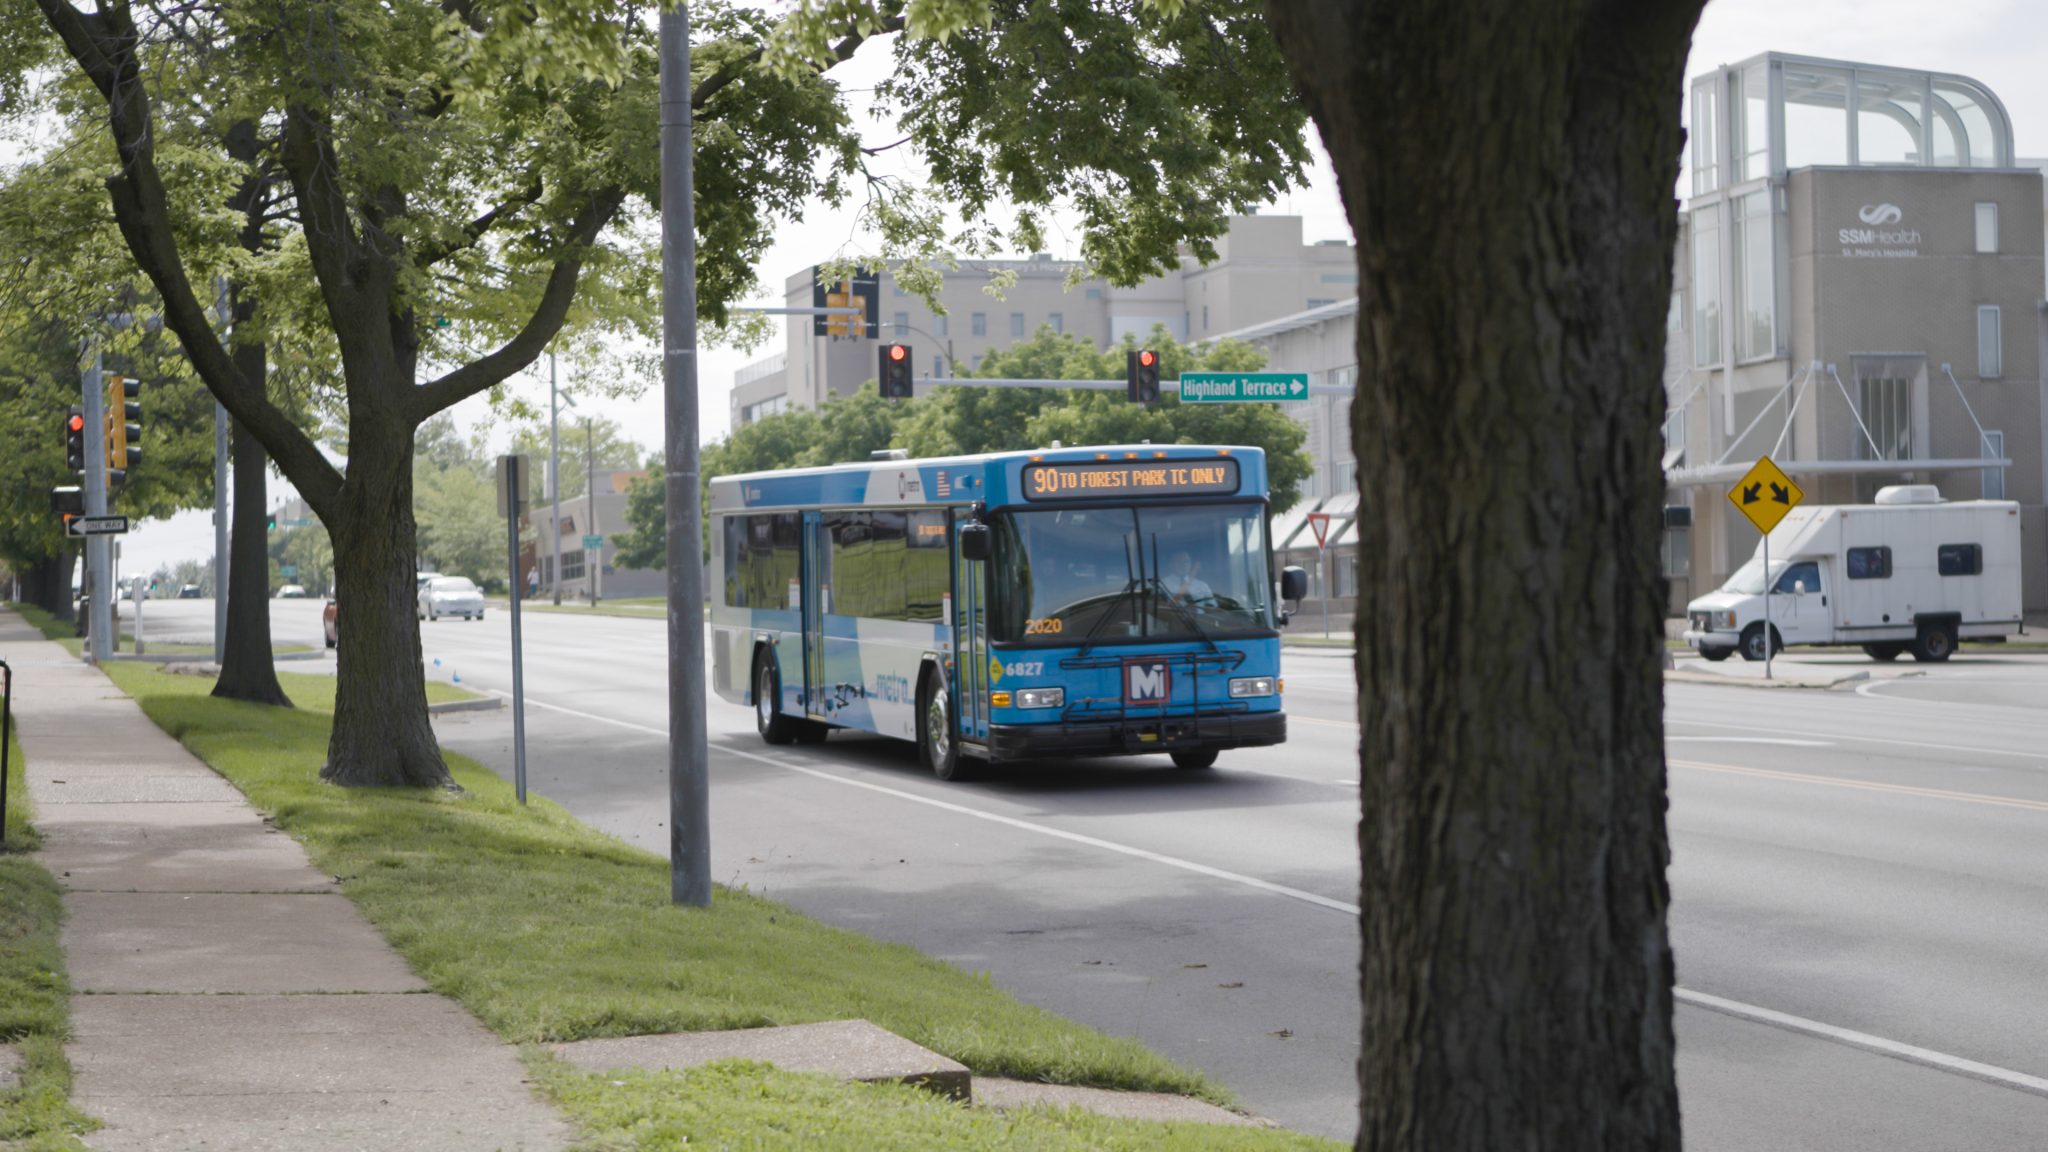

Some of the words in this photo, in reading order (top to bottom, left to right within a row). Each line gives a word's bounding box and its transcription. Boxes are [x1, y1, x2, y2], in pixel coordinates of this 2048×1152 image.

[1183, 379, 1236, 400] Highland
[1241, 379, 1287, 396] Terrace
[1034, 468, 1058, 493] 90
[1059, 472, 1077, 488] TO
[1080, 470, 1128, 488] FOREST
[1132, 469, 1166, 486] PARK
[1170, 468, 1188, 485] TC
[1191, 467, 1225, 484] ONLY
[104, 520, 122, 529] WAY
[1024, 618, 1063, 635] 2020
[1005, 662, 1044, 677] 6827
